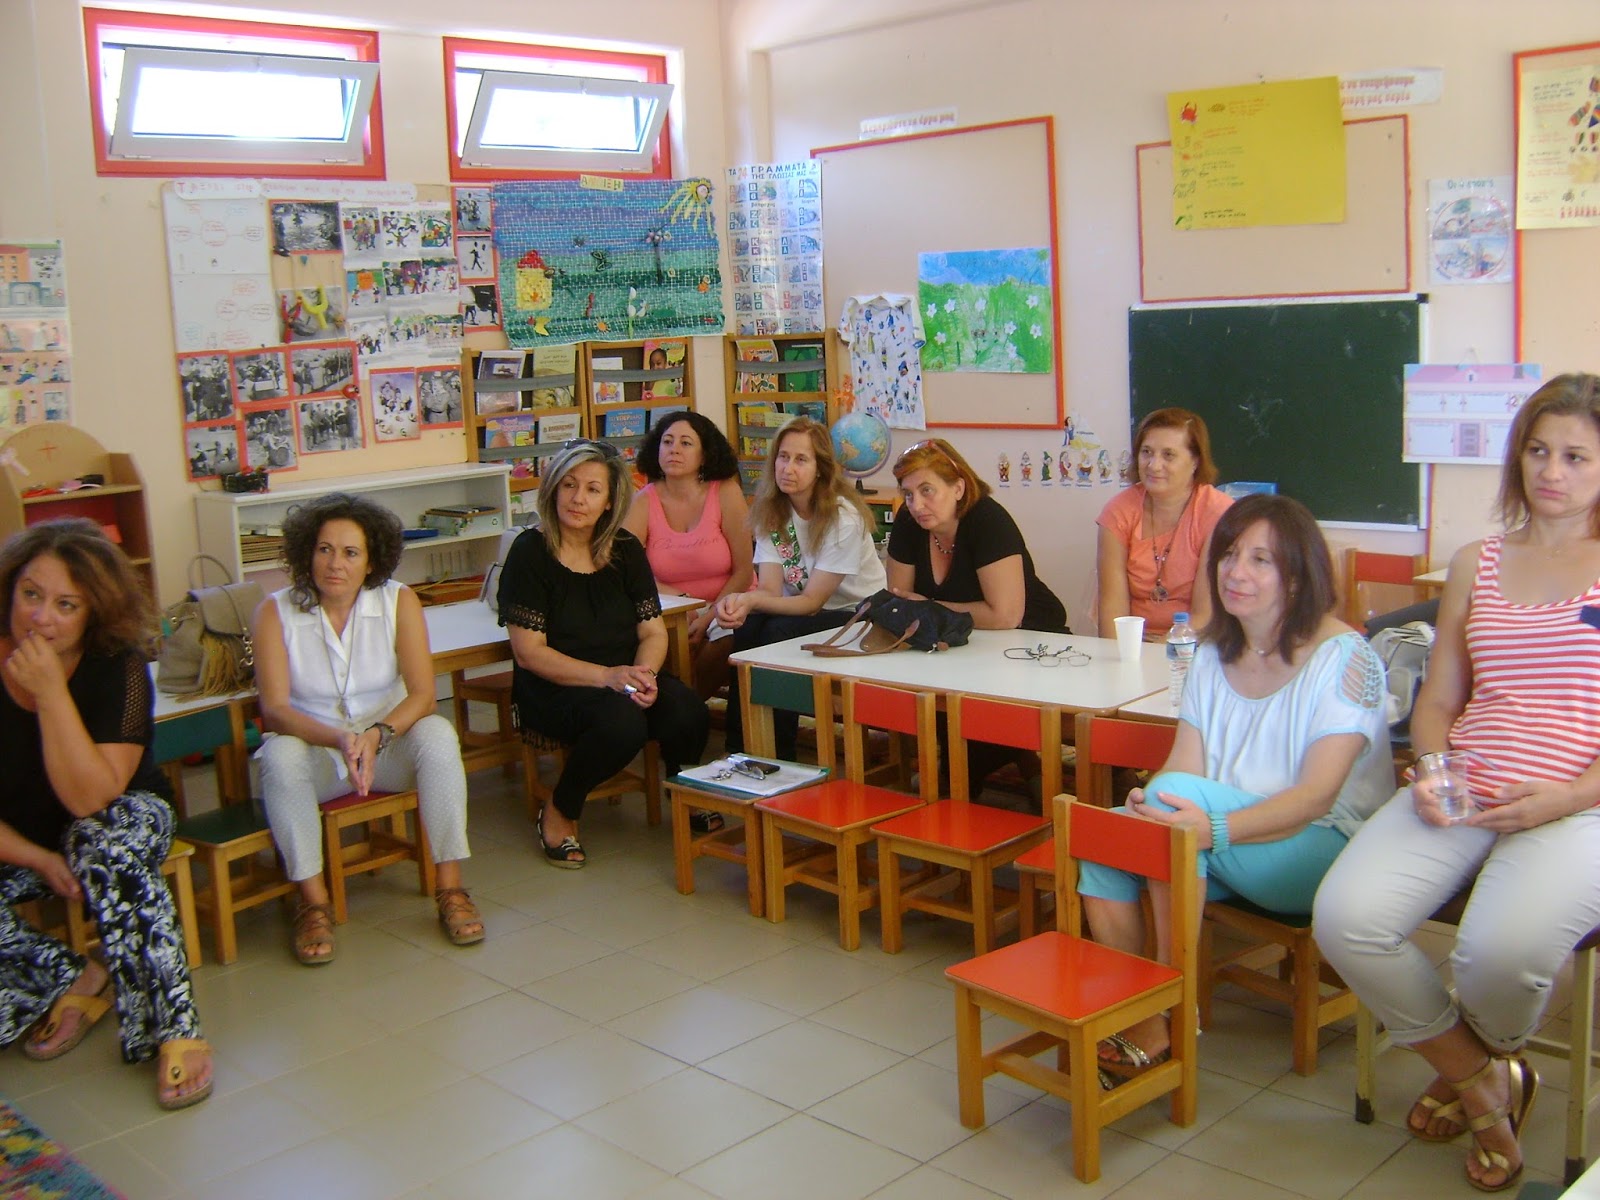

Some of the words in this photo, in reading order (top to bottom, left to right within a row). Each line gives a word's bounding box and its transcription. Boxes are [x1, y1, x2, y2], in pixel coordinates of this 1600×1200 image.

[728, 168, 737, 176] ΤΑ
[751, 162, 807, 173] ΓΡΑΜΜΑΤΑ
[768, 171, 795, 179] ΓΛΩΣΣΑΣ
